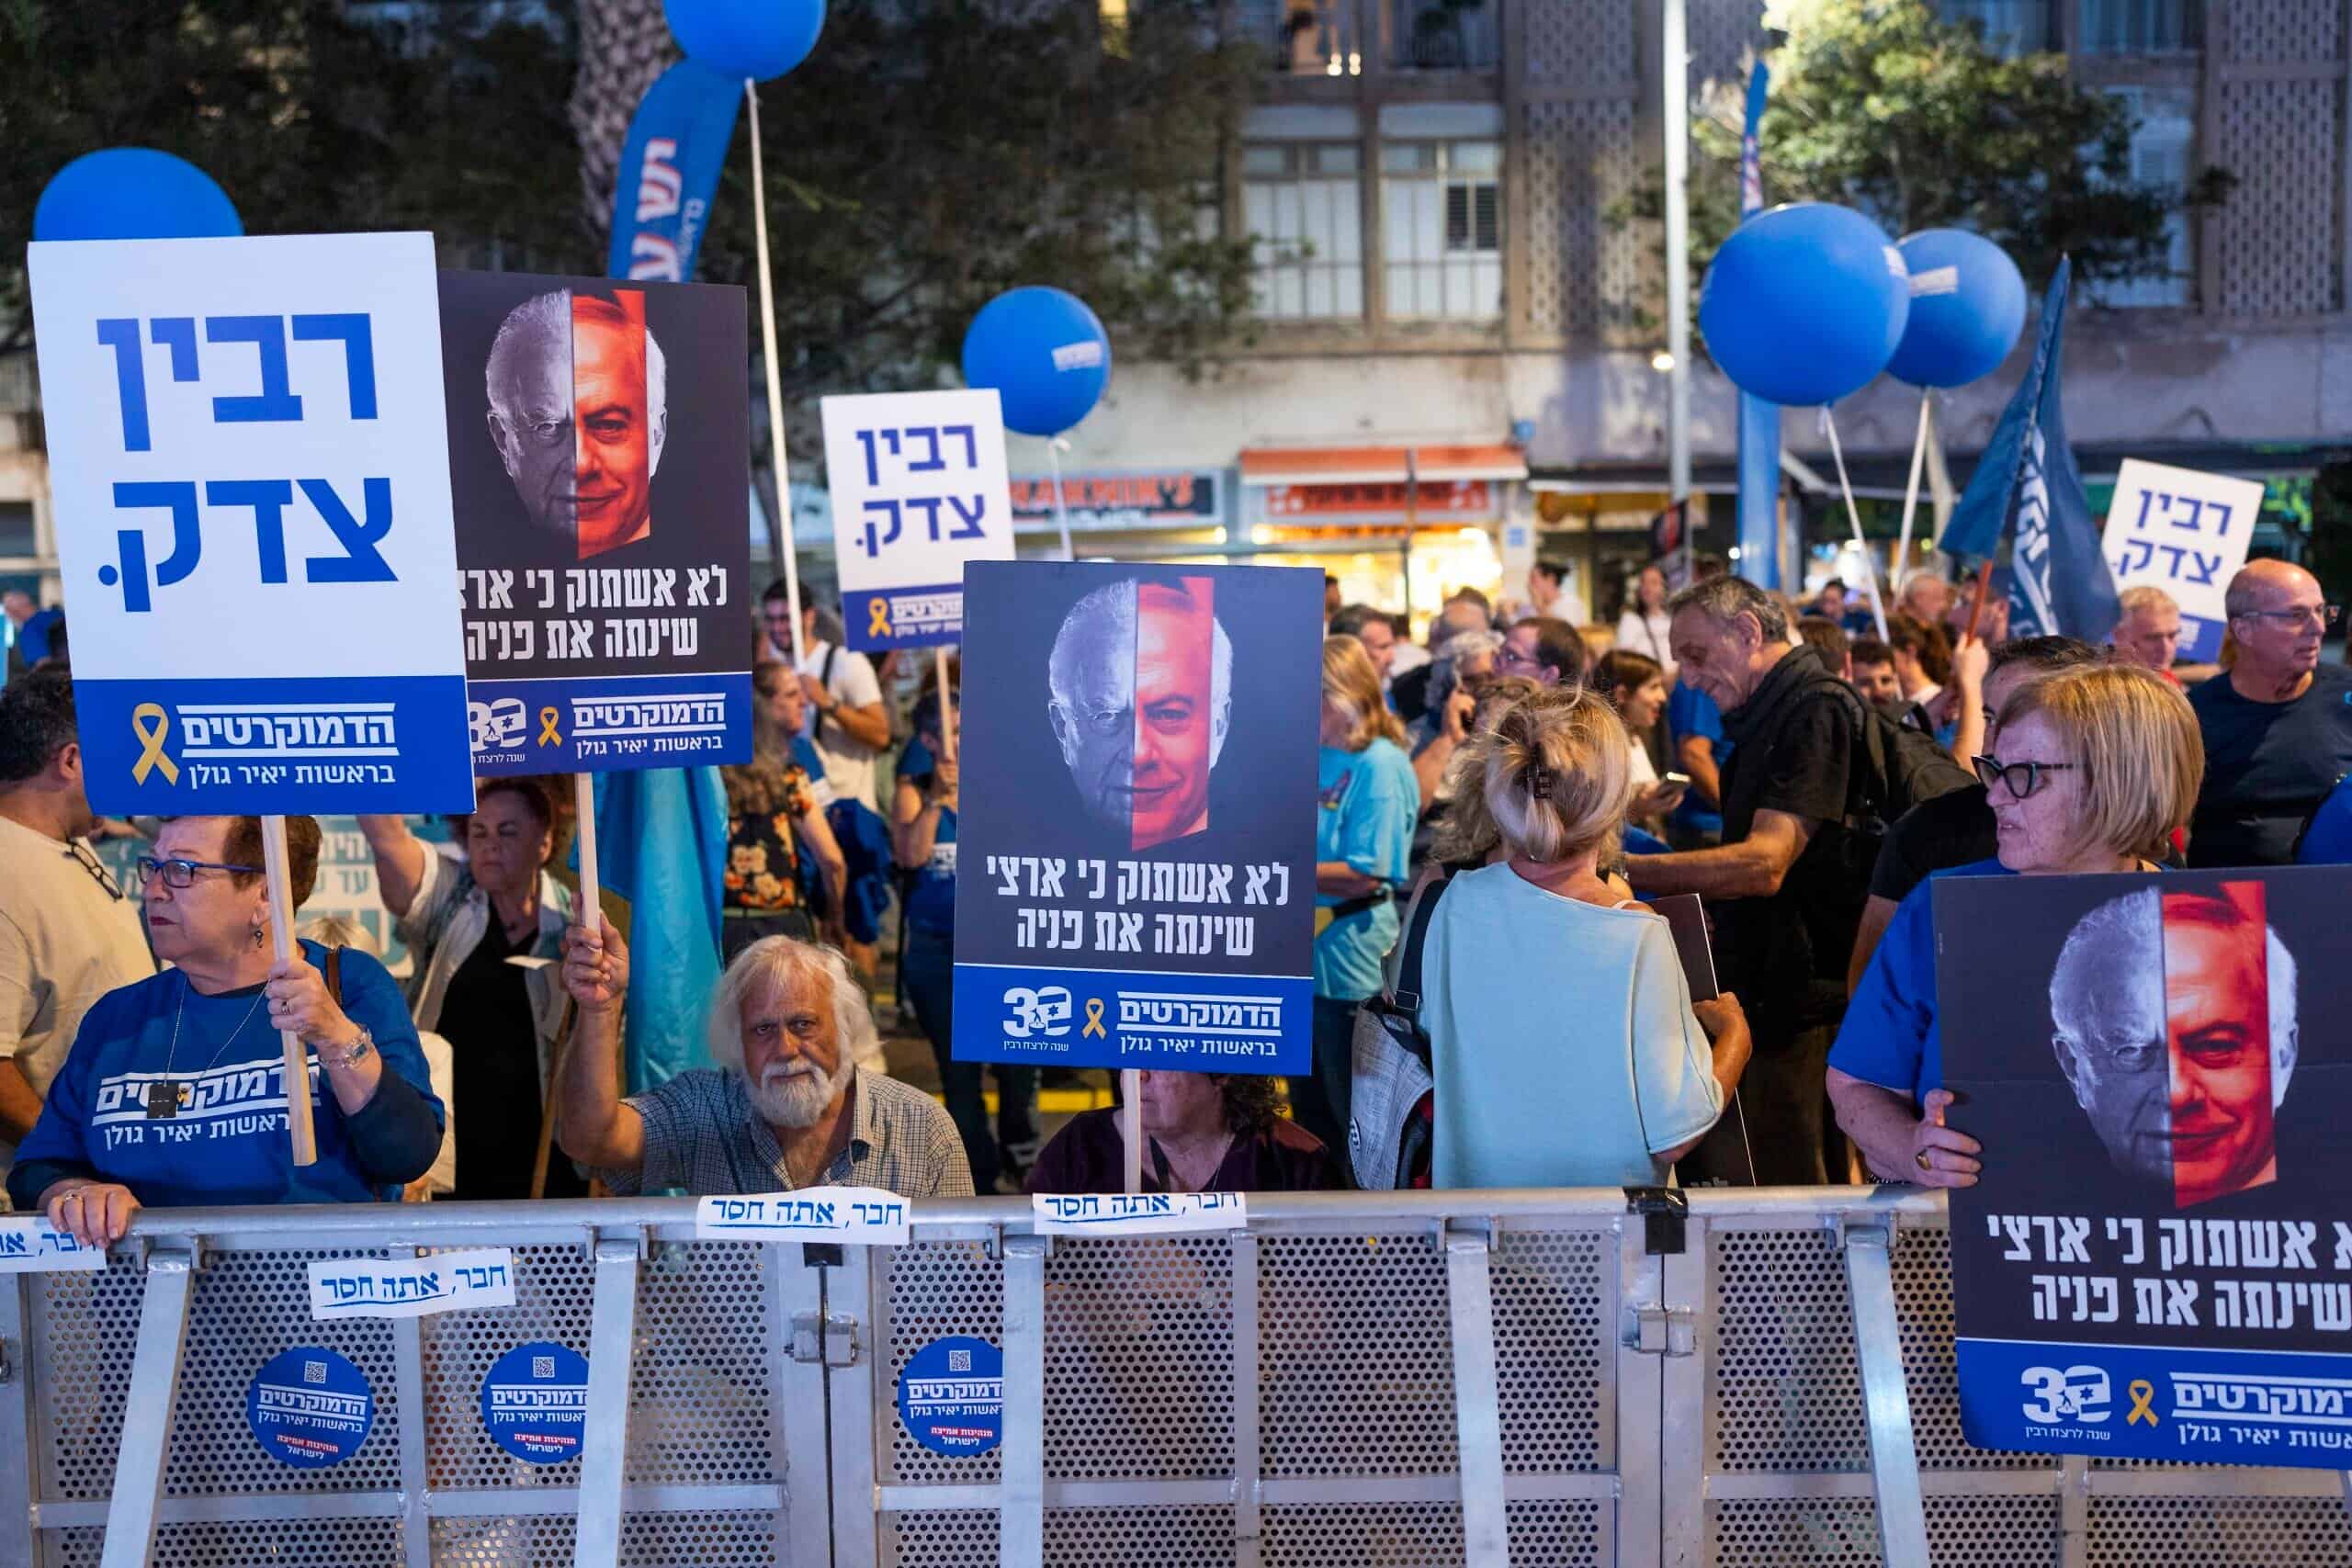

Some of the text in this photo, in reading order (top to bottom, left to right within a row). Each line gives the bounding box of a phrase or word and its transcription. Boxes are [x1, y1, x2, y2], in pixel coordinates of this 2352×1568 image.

[96, 312, 379, 451] רבין
[855, 424, 978, 486] רבין
[855, 493, 986, 558] צדק.
[2139, 489, 2233, 536] רבין
[97, 477, 399, 613] צדק.
[526, 570, 555, 609] כי
[565, 568, 676, 613] אשתוק
[686, 564, 728, 606] לא
[467, 617, 698, 660] שינתה את פניה
[572, 700, 726, 728] הדמוקרטים
[181, 716, 396, 750] הדמוקרטים
[576, 736, 723, 760] בראשות יאיר גולן
[478, 753, 504, 763] לרצח
[506, 753, 526, 762] שנה
[188, 764, 396, 790] בראשות יאיר גולן
[986, 855, 1066, 897] ארצי
[1078, 859, 1106, 899] כי
[1117, 860, 1233, 905] אשתוק
[1244, 862, 1289, 906] לא
[1017, 908, 1254, 956] שינתה את פניה
[1118, 999, 1281, 1030] הדמוקרטים
[1003, 1040, 1069, 1052] שנה לרצח רבין
[1120, 1034, 1277, 1056] בראשות יאיר גולן
[104, 1113, 291, 1151] ראשות יאיר גולן
[711, 1200, 903, 1229] חבר, אתה חסר
[1045, 1197, 1099, 1216] חסר
[1112, 1195, 1170, 1214] אתה
[39, 1232, 96, 1257] בר,
[1987, 1214, 2352, 1271] א אשתוק כי ארצי
[322, 1266, 505, 1299] חבר, אתה חסר
[2032, 1275, 2352, 1331] שינתה את פניה
[259, 1389, 367, 1416] הדמוקרטים
[910, 1405, 932, 1418] גולן
[933, 1405, 960, 1416] יאיר
[2174, 1382, 2352, 1417] מוקרטים
[258, 1410, 364, 1433] בראשות יאיר גולן
[493, 1411, 515, 1425] גולן
[517, 1412, 543, 1422] יאיר
[2025, 1426, 2110, 1440] שנה לרצח רבין
[2177, 1423, 2222, 1445] גולן
[2229, 1426, 2280, 1445] יאיר
